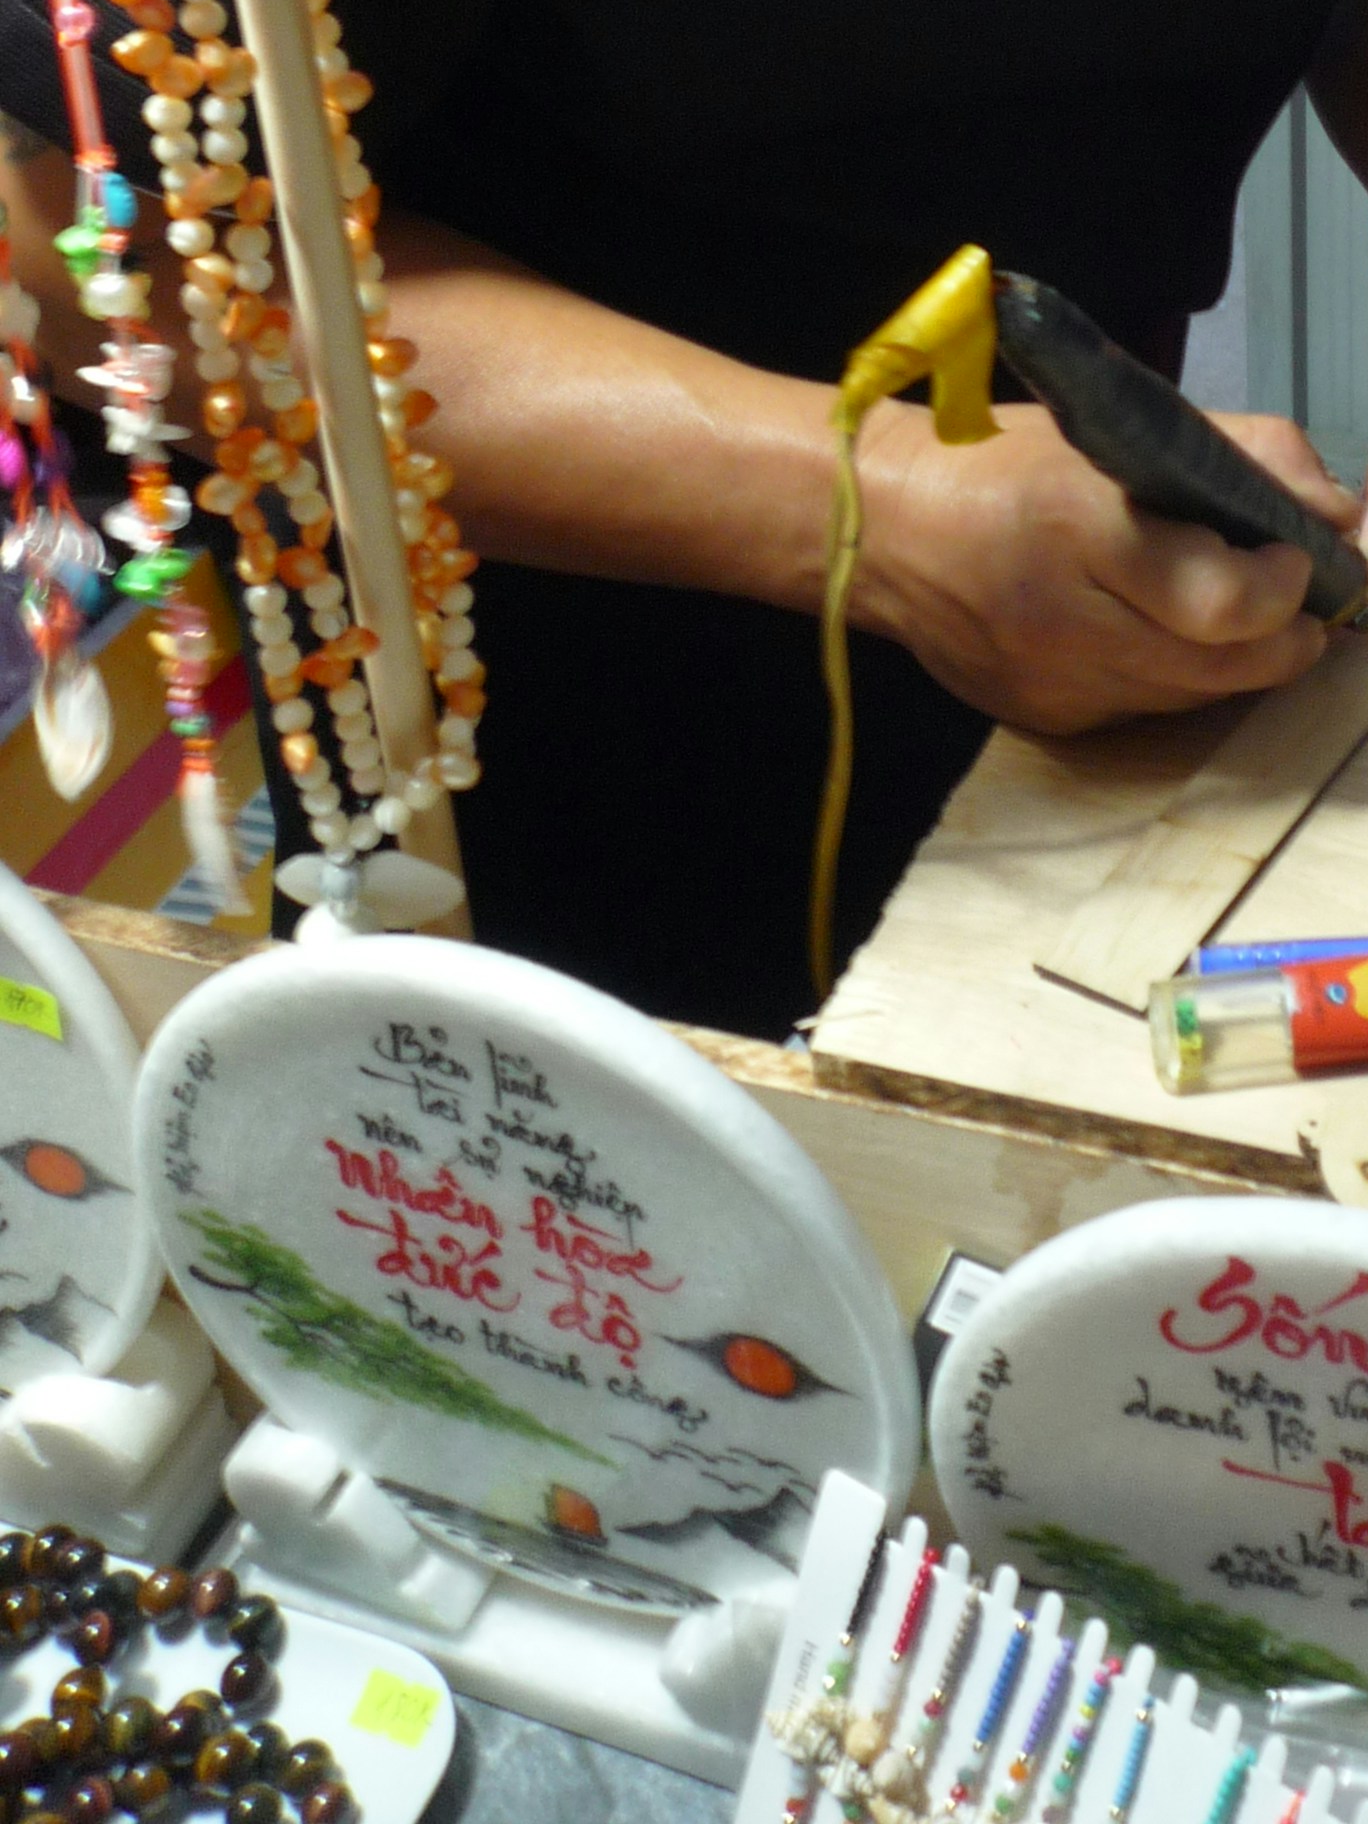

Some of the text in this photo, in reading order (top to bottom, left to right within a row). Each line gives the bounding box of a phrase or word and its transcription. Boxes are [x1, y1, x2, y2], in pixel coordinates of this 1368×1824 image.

[374, 1023, 472, 1082] Bản
[356, 1113, 422, 1153] nên
[336, 1205, 642, 1370] đức độ
[387, 1288, 709, 1433] tạo thành công
[1122, 1375, 1248, 1443] danh
